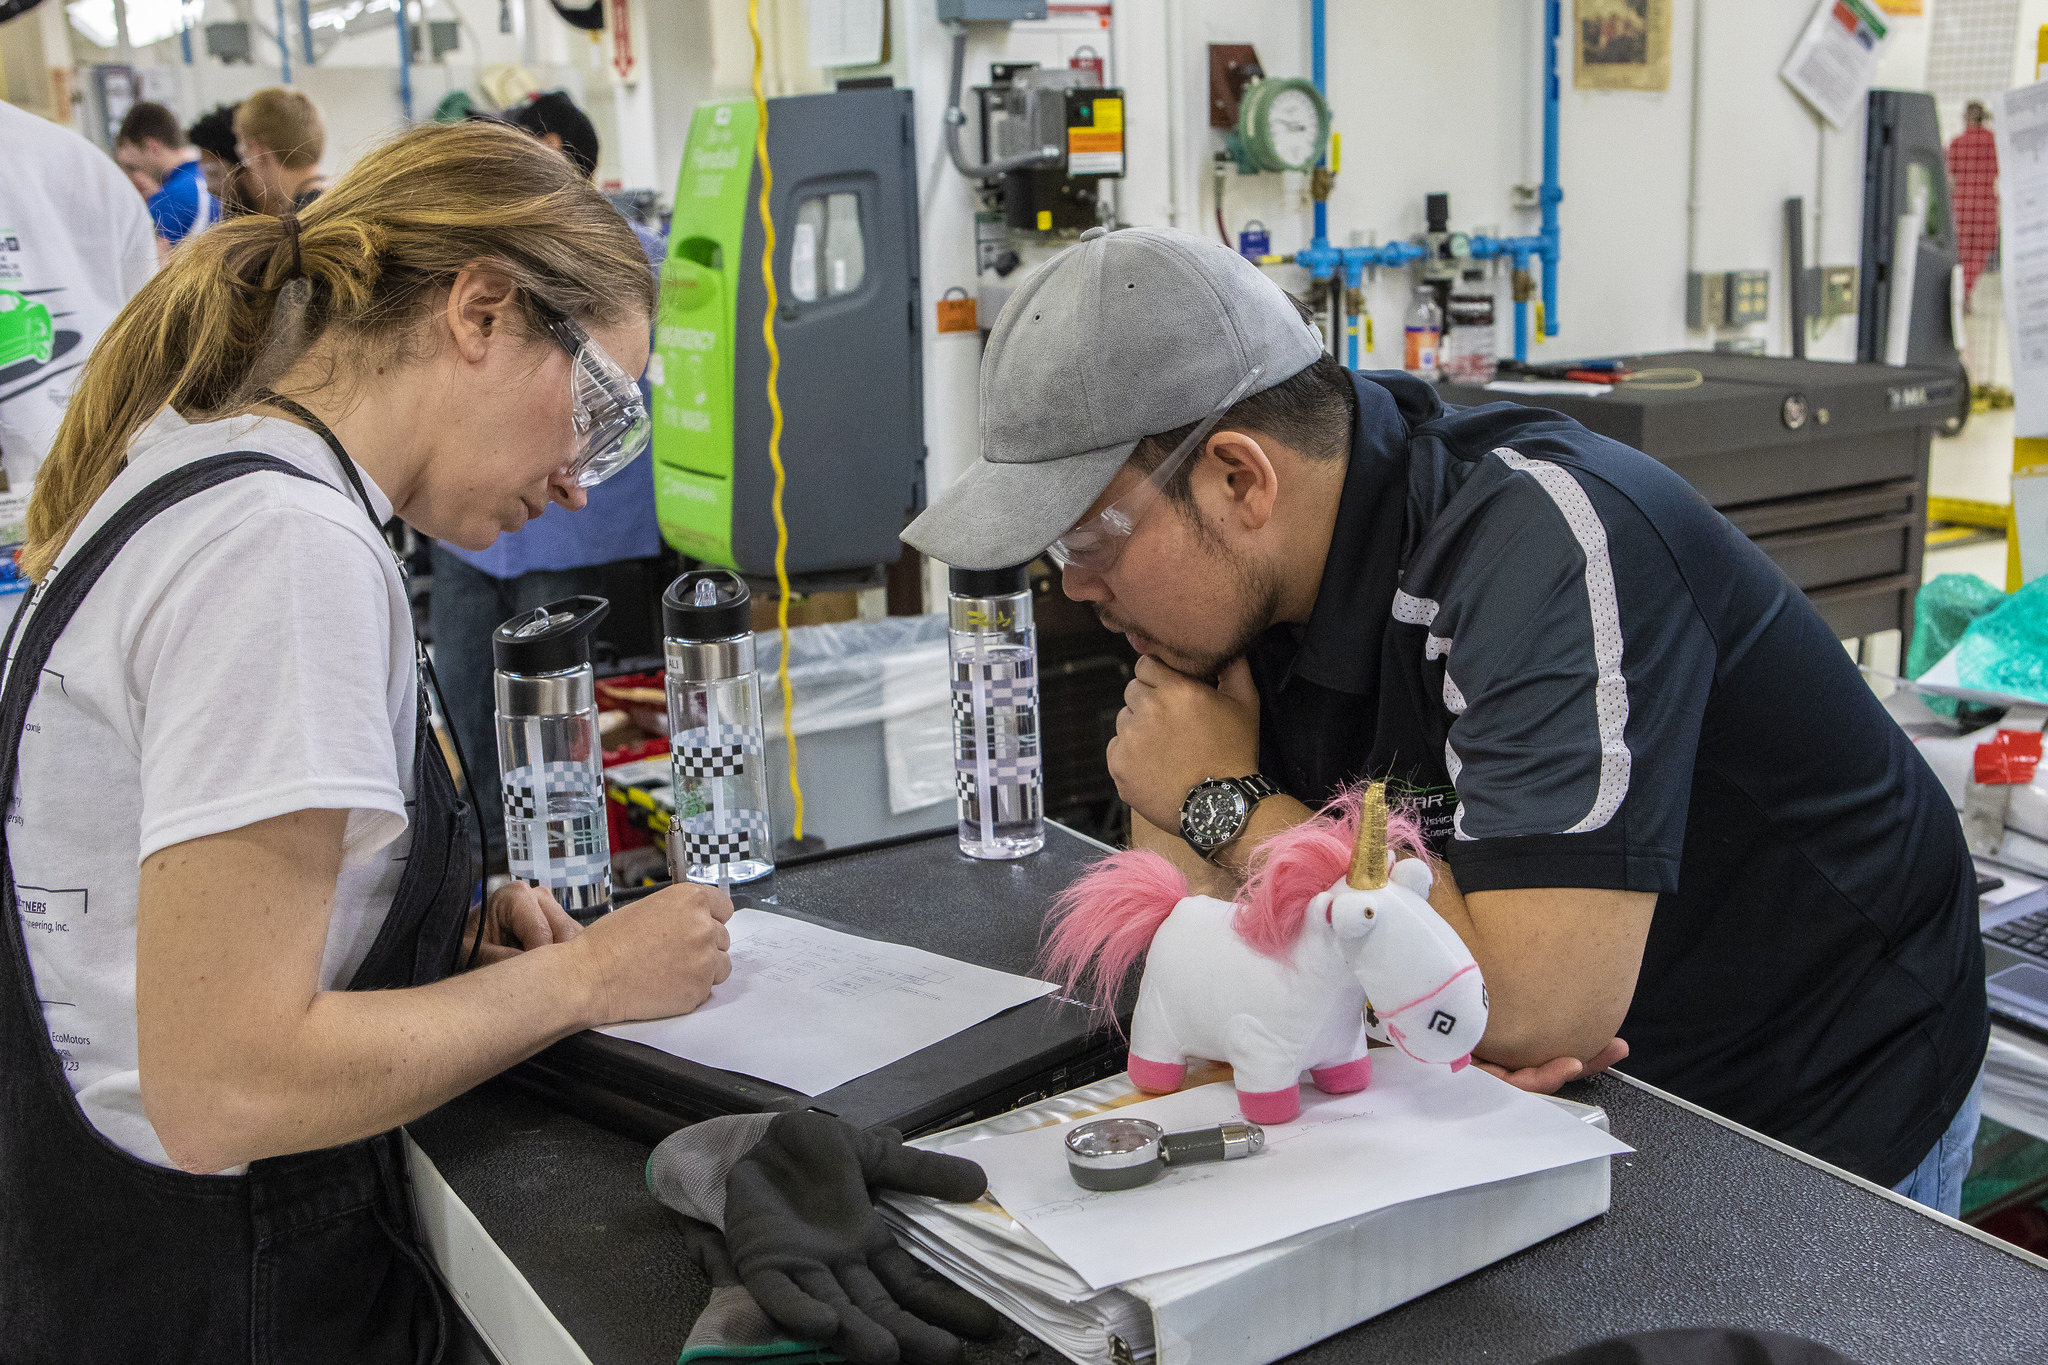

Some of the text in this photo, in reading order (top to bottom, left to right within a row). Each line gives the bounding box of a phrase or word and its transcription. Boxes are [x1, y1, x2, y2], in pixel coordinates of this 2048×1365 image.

[55, 921, 70, 932] Inc.
[51, 1031, 91, 1046] EcoMotors
[63, 1061, 80, 1071] 123
